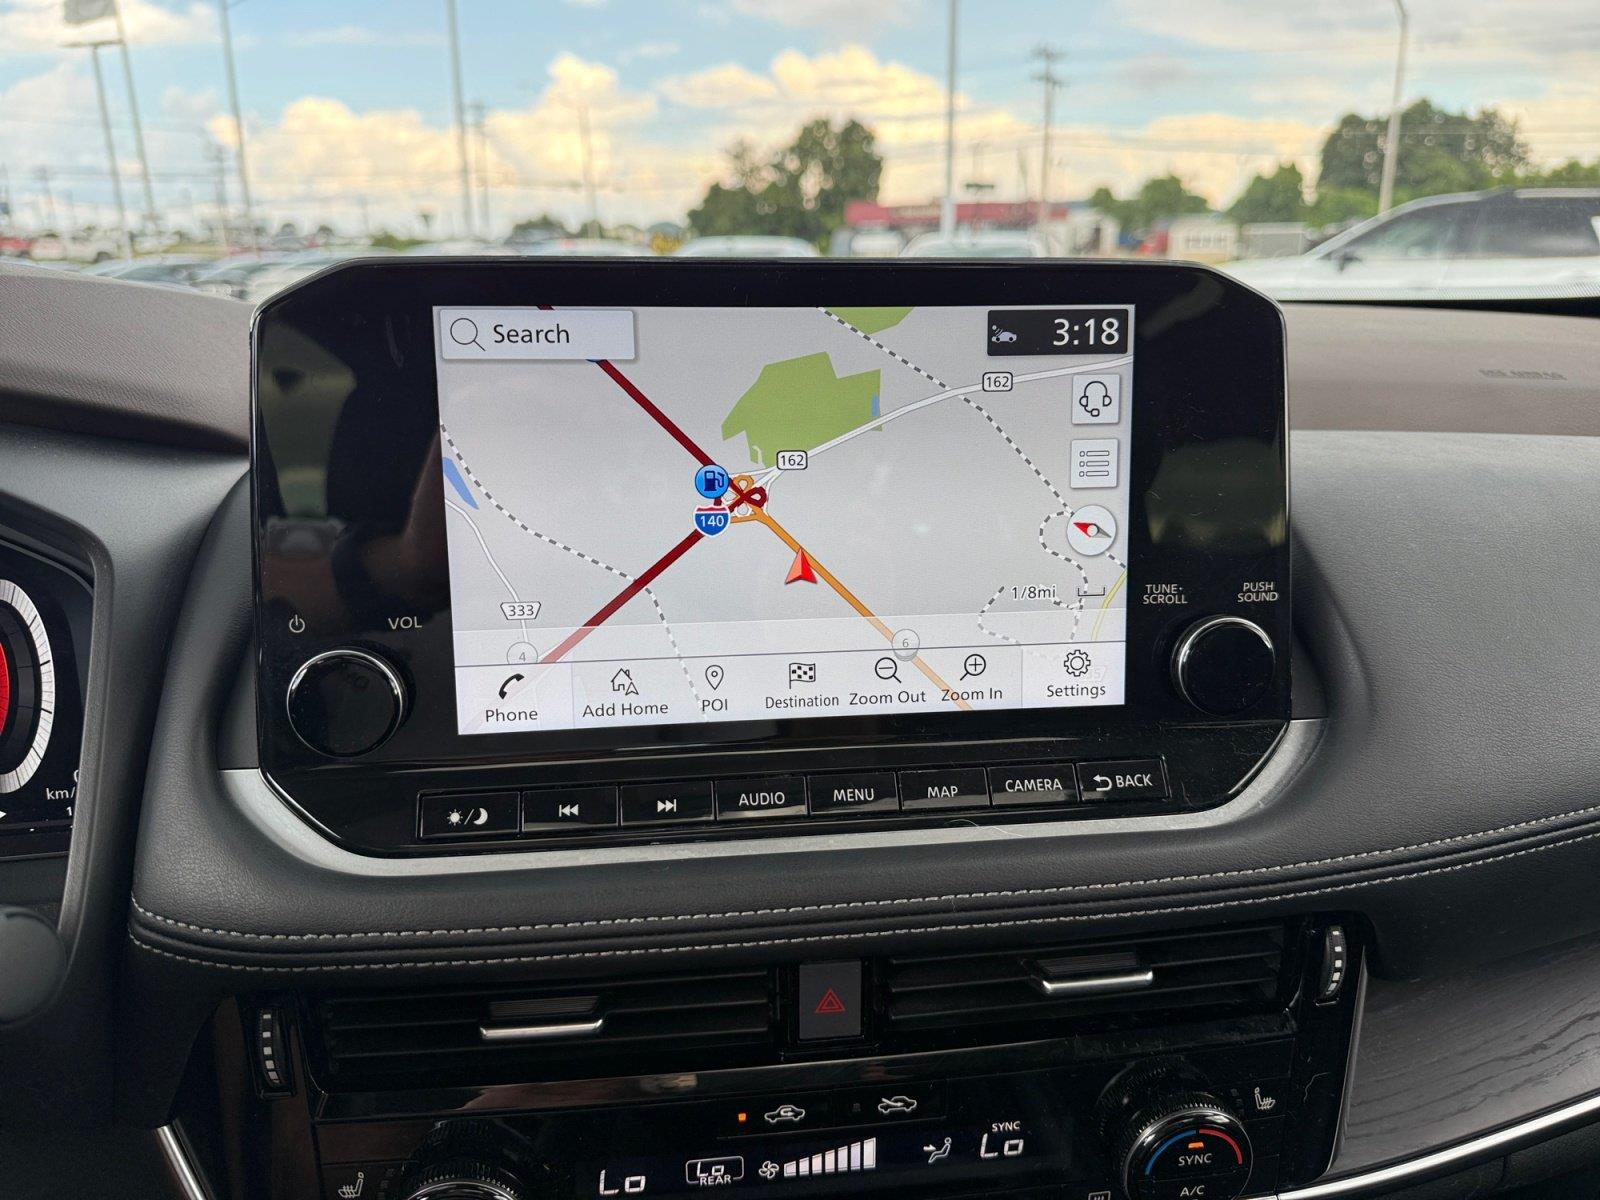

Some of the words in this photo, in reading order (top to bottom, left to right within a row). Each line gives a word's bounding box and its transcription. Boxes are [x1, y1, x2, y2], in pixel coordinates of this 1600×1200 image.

[493, 324, 570, 344] Search
[1053, 318, 1120, 346] 3:18
[986, 376, 1009, 389] 162
[780, 454, 804, 468] 162
[700, 515, 725, 529] 140
[1012, 585, 1057, 600] 1/8mi
[1243, 582, 1274, 592] PUSH
[1143, 594, 1188, 605] SCROLL
[1237, 592, 1279, 603] SOUND
[508, 604, 534, 617] 333
[388, 616, 422, 629] VOL
[902, 638, 909, 648] 6
[518, 651, 526, 662] 4
[850, 692, 892, 705] Zoom
[898, 690, 926, 704] Out
[941, 689, 985, 702] Zoom
[990, 688, 1003, 700] In
[1047, 684, 1107, 699] Settings
[701, 698, 728, 712] POI
[765, 695, 840, 709] Destination
[485, 707, 538, 723] Phone
[582, 703, 622, 719] Add
[622, 701, 669, 717] Home
[1005, 778, 1063, 793] CAMERA
[1115, 773, 1153, 788] BACK
[738, 792, 786, 807] AUDIO
[833, 787, 875, 802] MENU
[927, 786, 959, 799] MAP
[991, 1121, 1021, 1132] SYNC
[980, 1134, 1024, 1159] Lo
[1178, 1154, 1213, 1167] SYNC
[696, 1161, 724, 1177] Lo
[600, 1169, 647, 1196] Lo
[700, 1175, 732, 1186] REAR
[1180, 1186, 1206, 1198] A/C
